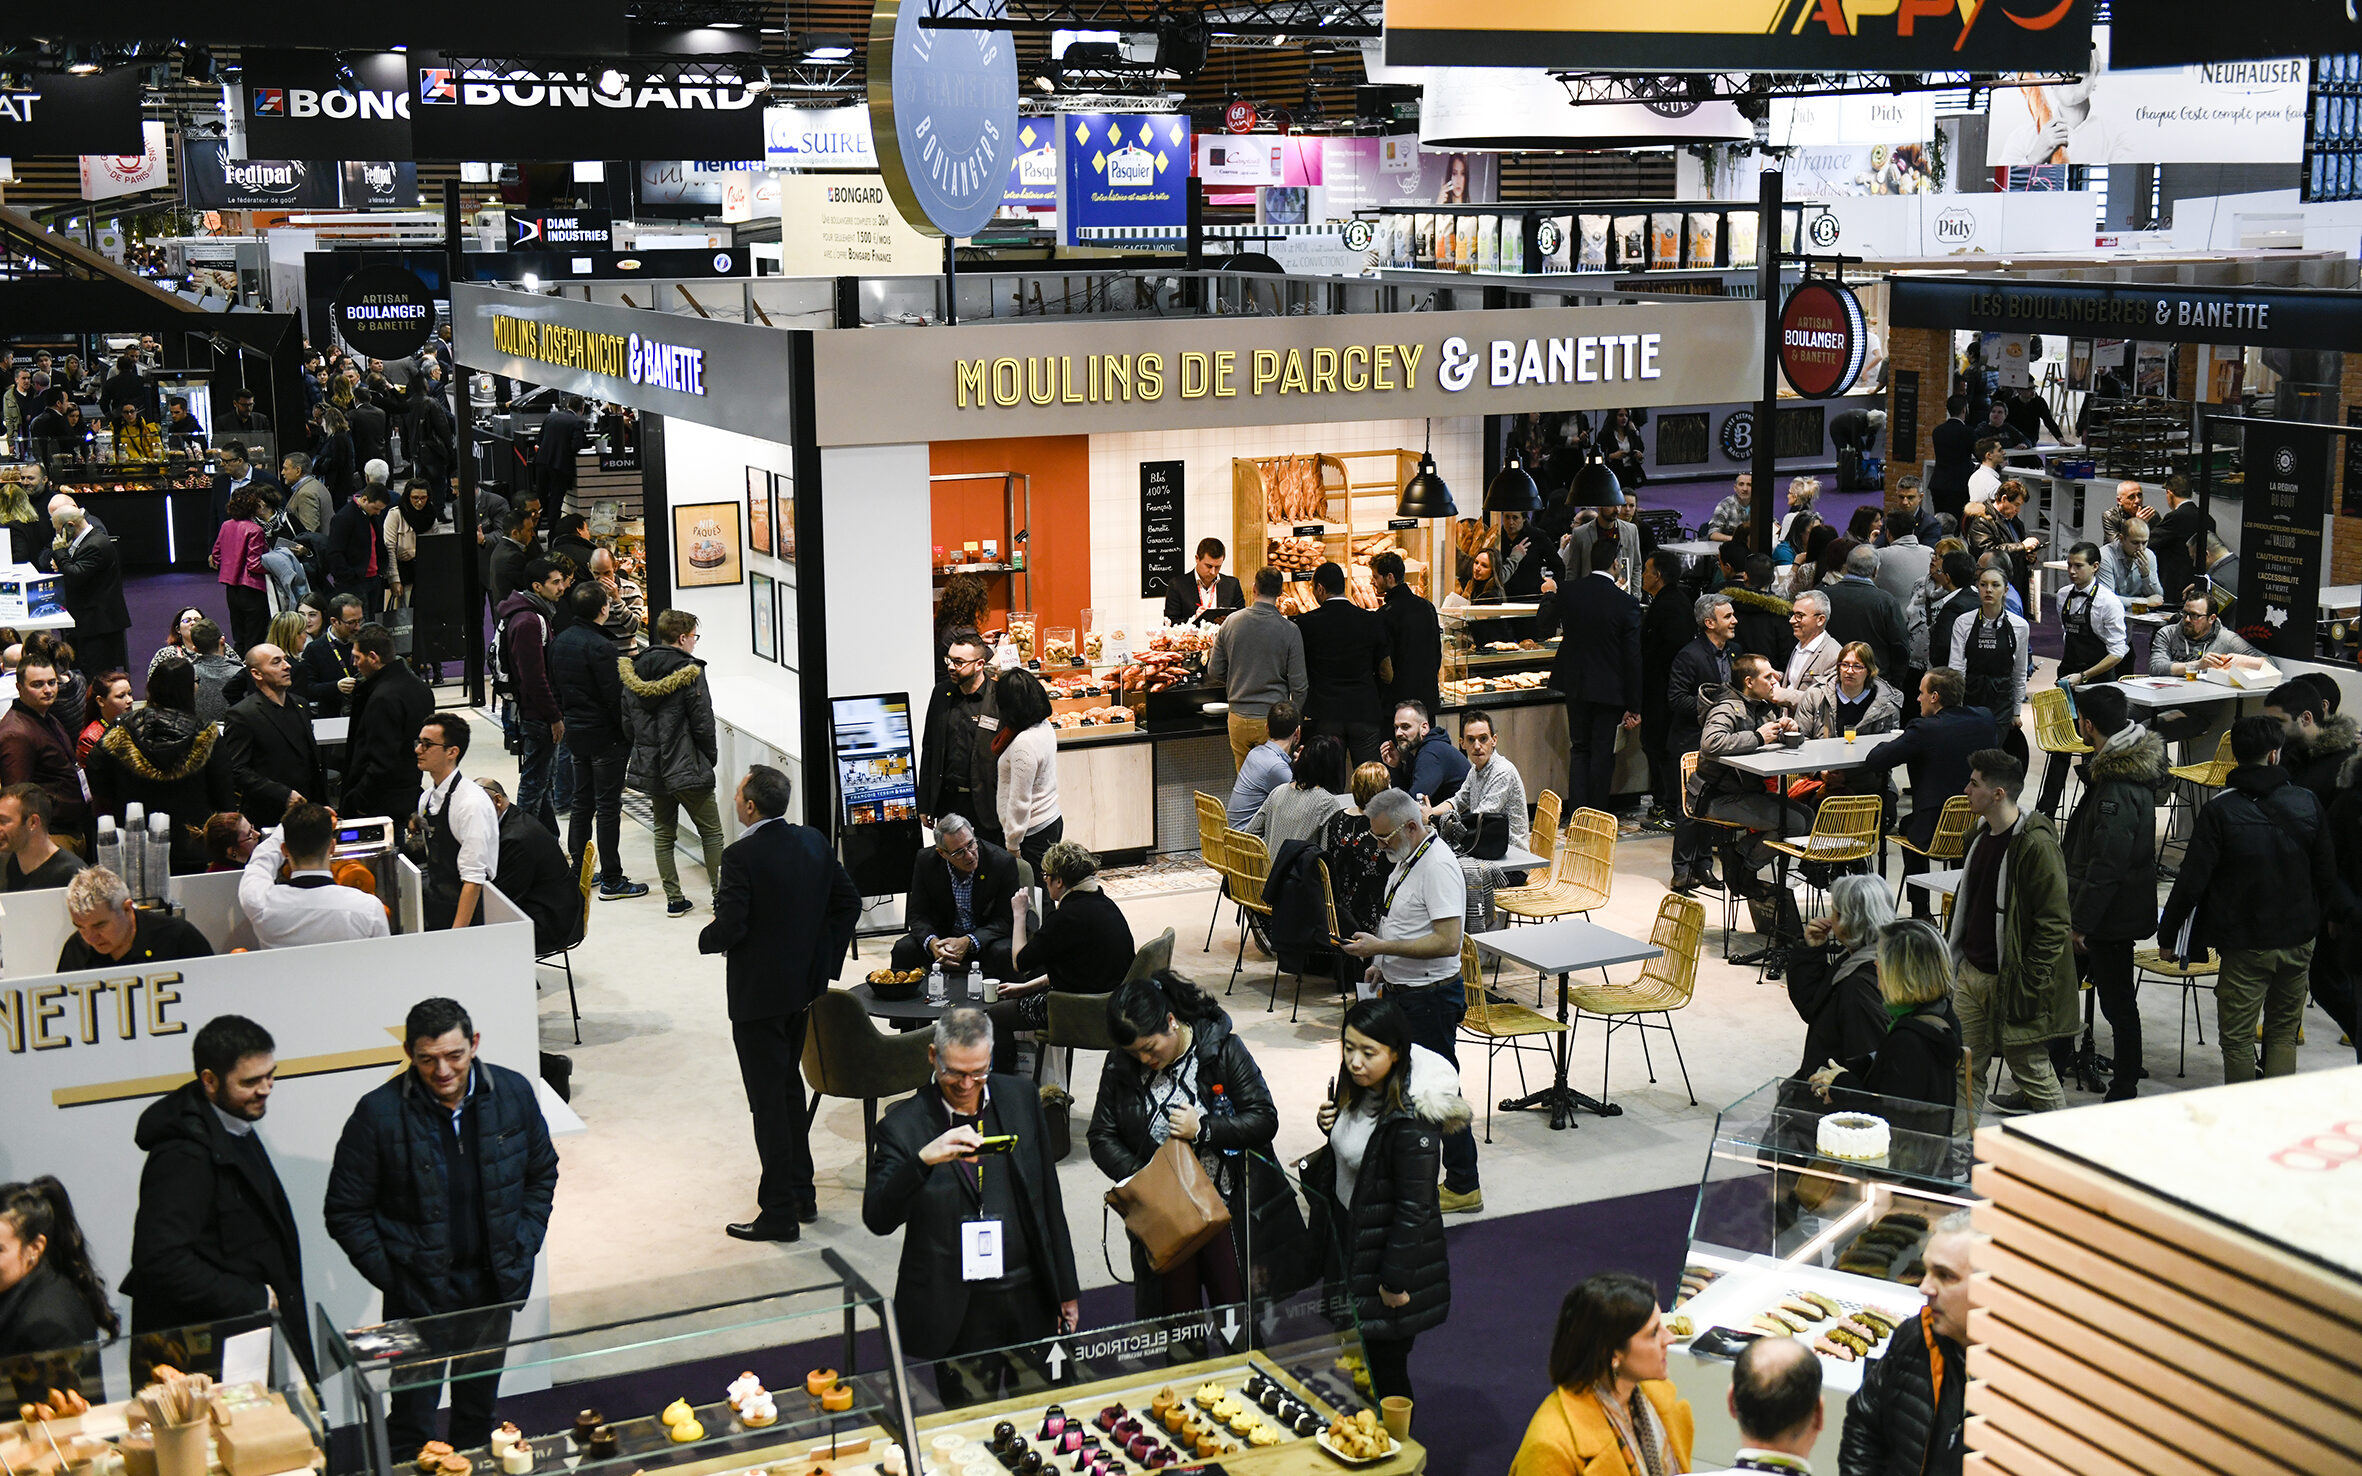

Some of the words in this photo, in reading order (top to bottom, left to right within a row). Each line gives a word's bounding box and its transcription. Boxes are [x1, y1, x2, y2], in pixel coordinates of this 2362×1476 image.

[2200, 60, 2301, 84] NEUHAUSER
[926, 70, 1010, 109] BANETTE
[1871, 104, 1904, 124] Pidy
[2136, 106, 2177, 127] Chaque
[2180, 105, 2208, 121] Geste
[2213, 107, 2252, 125] compte
[2256, 109, 2281, 125] pour
[801, 132, 868, 154] SUIRE
[915, 115, 1000, 197] BOULANGERS
[109, 170, 122, 183] DE
[124, 170, 150, 184] PARIS
[225, 164, 293, 187] Fedipat
[1111, 160, 1150, 182] Pasquier
[227, 196, 236, 204] Le
[270, 196, 279, 204] de
[834, 187, 883, 204] BONGARD
[546, 217, 579, 230] DIANE
[1938, 218, 1973, 237] Pidy
[547, 229, 609, 242] INDUSTRIES
[856, 231, 872, 244] 1500
[848, 248, 871, 261] BONGARD
[872, 248, 892, 263] FINANCE
[362, 294, 409, 304] ARTISAN
[347, 304, 426, 319] BOULANGER
[1970, 294, 2001, 317] LES
[2154, 299, 2171, 325] &
[2178, 301, 2269, 329] BANETTE
[357, 321, 366, 331] &
[369, 320, 417, 331] BANETTE
[1797, 316, 1833, 330] ARTISAN
[1784, 329, 1845, 349] BOULANGER
[493, 314, 537, 360] MOULINS
[539, 323, 584, 370] JOSEPH
[586, 331, 625, 378] NICOT
[628, 332, 643, 384] &
[643, 339, 704, 396] BANETTE
[1791, 349, 1798, 360] &
[1800, 350, 1836, 364] BANETTE
[955, 353, 1164, 409] MOULINS
[1180, 350, 1237, 399] DE
[1252, 344, 1425, 397] PARCEY
[1437, 336, 1479, 392] &
[1490, 334, 1661, 386] BANETTE
[1733, 422, 1752, 449] B
[1146, 484, 1171, 497] 100%
[2269, 482, 2277, 492] LA
[2272, 535, 2296, 549] VALEURS
[0, 971, 188, 1054] NETTE
